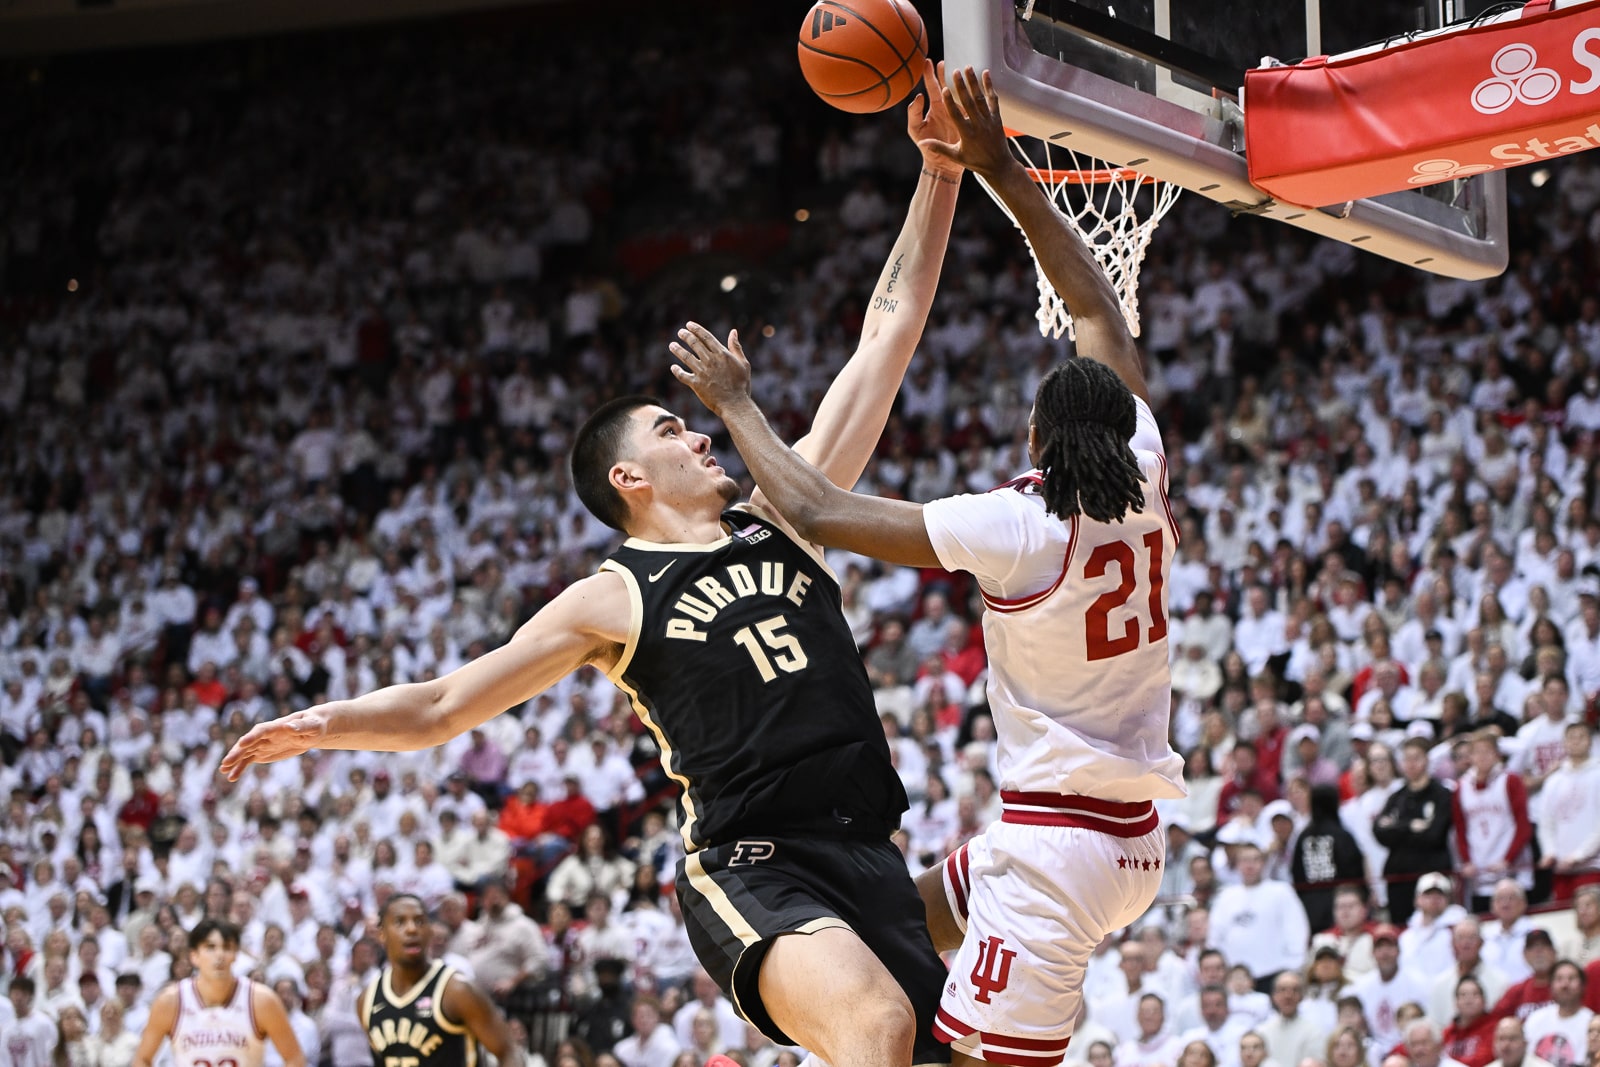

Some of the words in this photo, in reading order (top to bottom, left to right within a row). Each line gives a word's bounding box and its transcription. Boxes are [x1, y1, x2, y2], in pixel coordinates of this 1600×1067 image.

[665, 561, 813, 642] PURDUE
[1084, 527, 1167, 661] 21
[732, 614, 808, 683] 15
[728, 841, 775, 867] P
[369, 1017, 443, 1057] PURDUE
